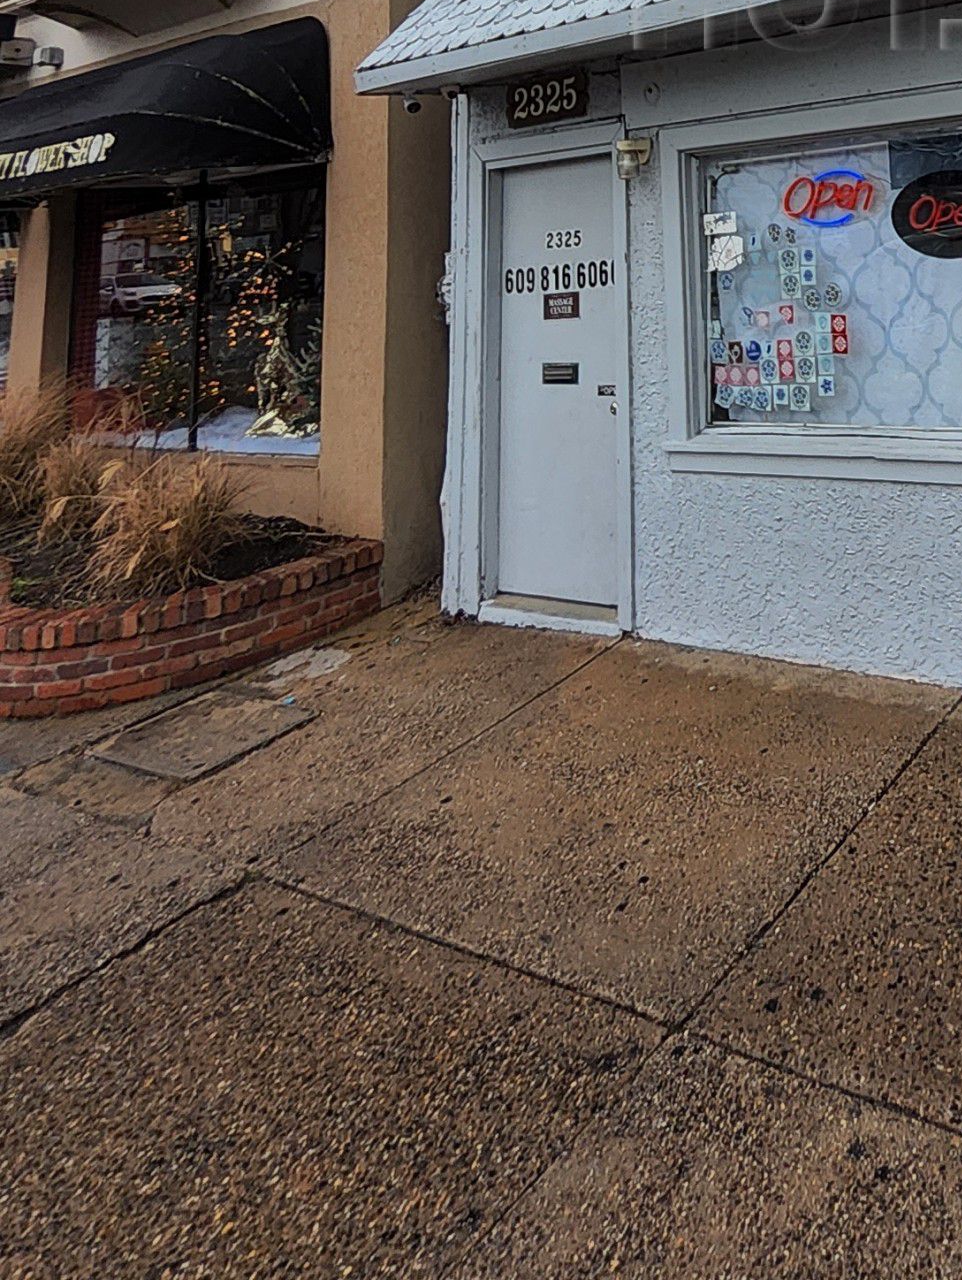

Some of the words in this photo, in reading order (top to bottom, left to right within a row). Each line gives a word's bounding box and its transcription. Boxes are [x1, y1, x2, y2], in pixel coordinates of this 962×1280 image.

[513, 76, 577, 120] 2325
[66, 132, 116, 168] SHOP
[783, 176, 874, 220] Open
[546, 230, 582, 249] 2325
[505, 268, 535, 294] 609
[541, 265, 571, 291] 816
